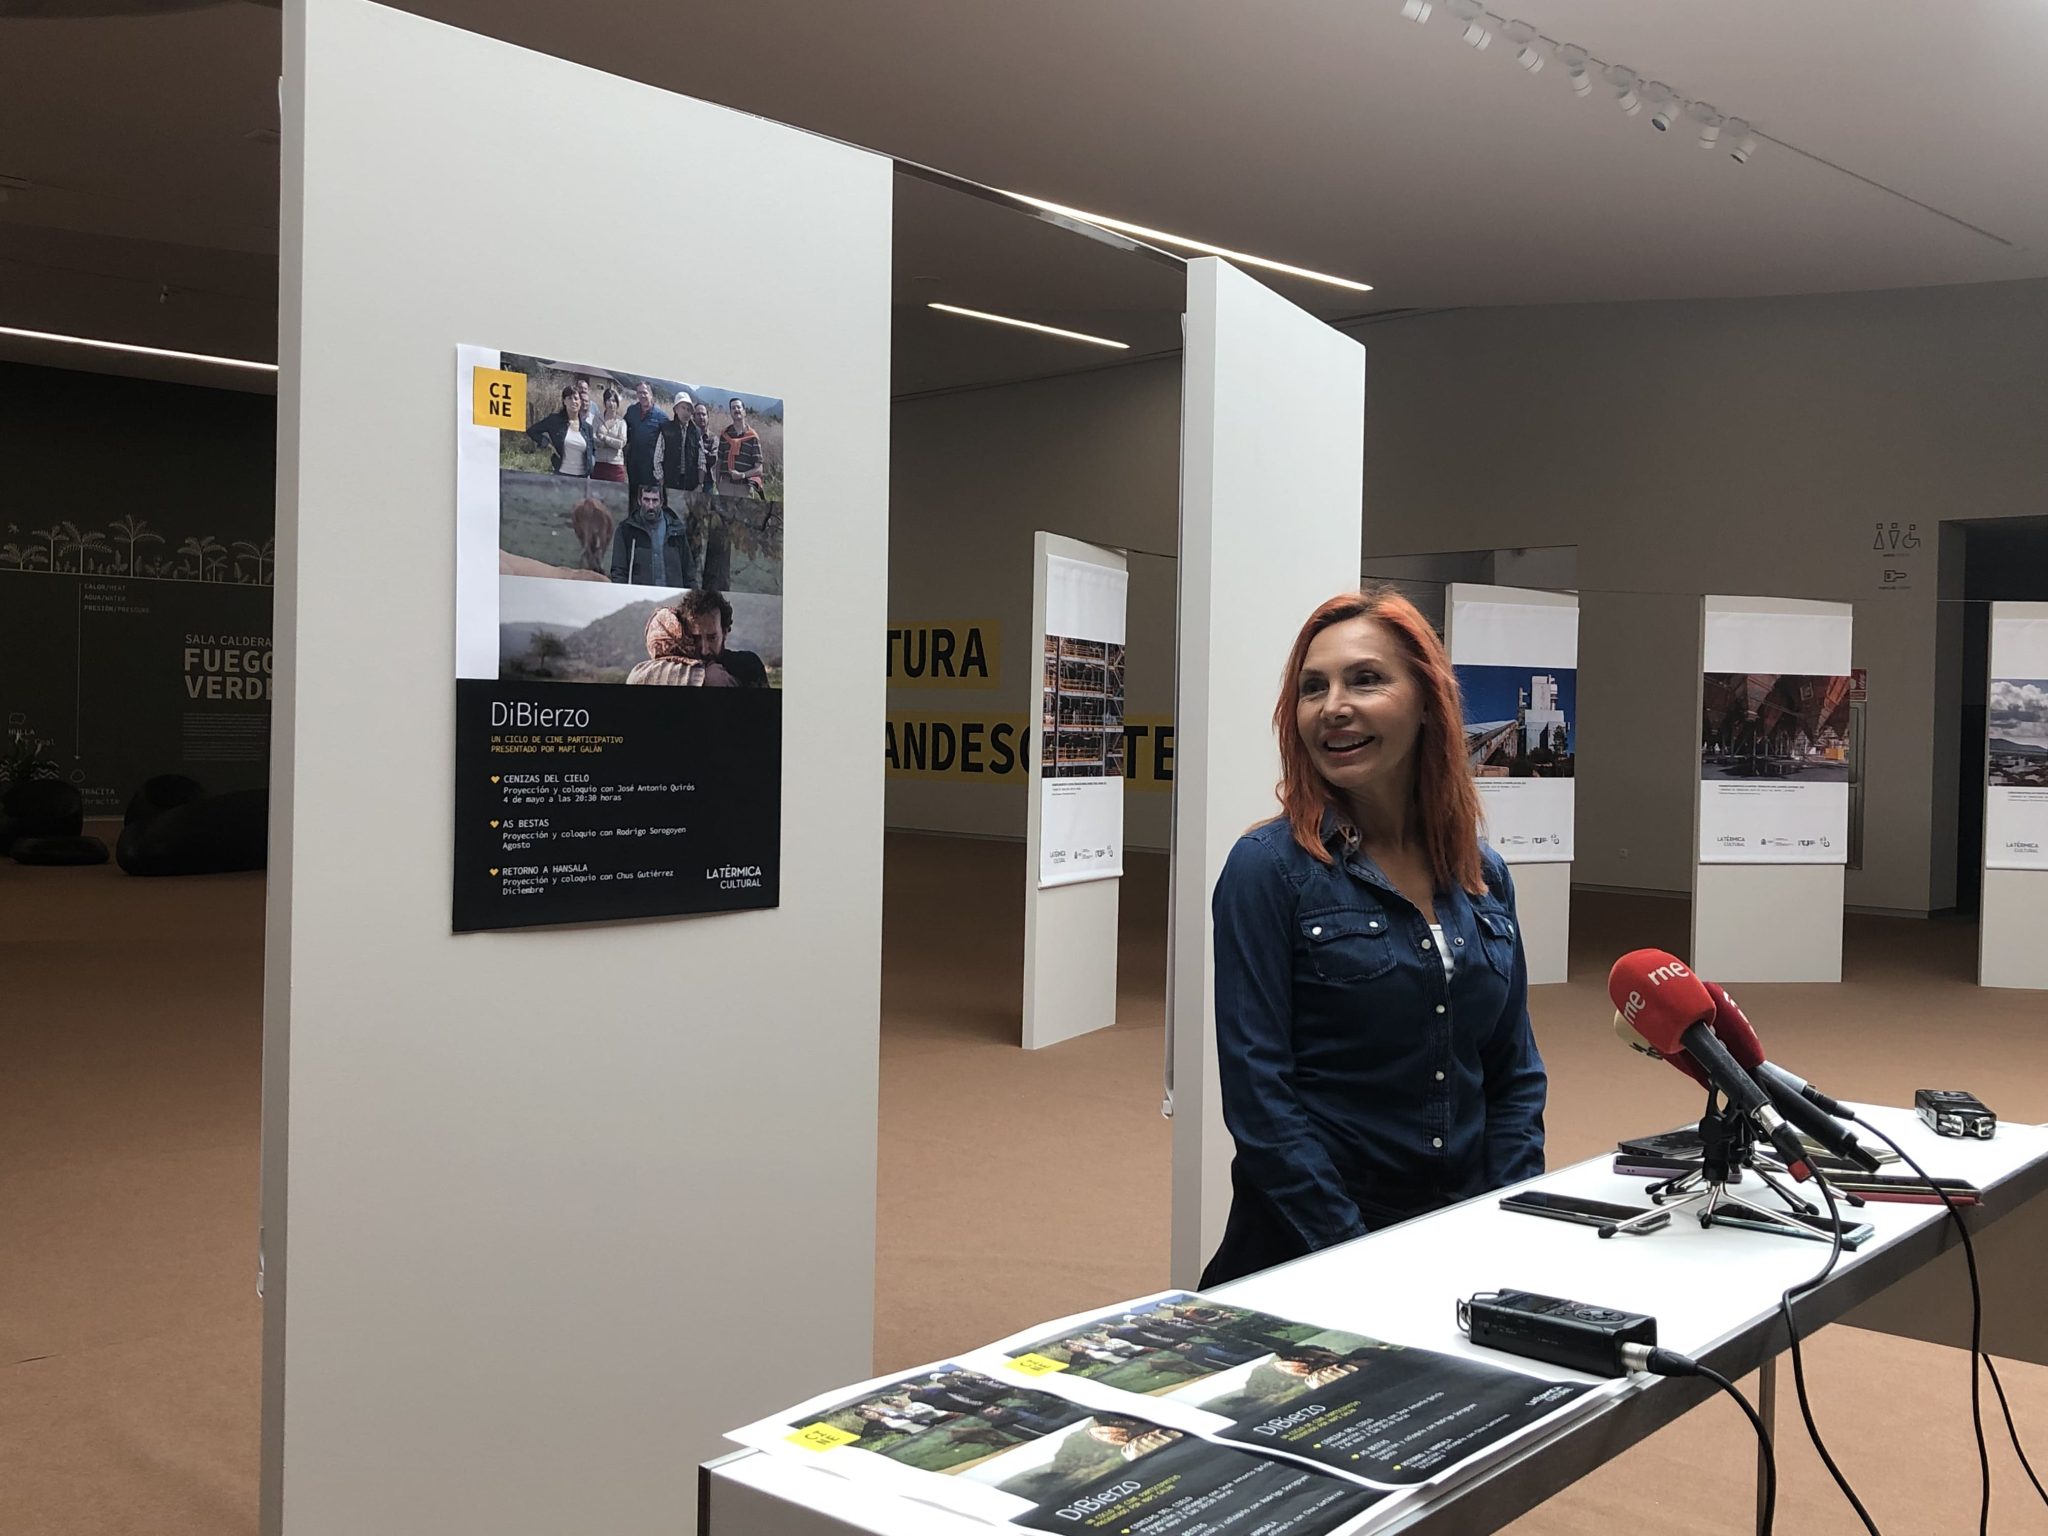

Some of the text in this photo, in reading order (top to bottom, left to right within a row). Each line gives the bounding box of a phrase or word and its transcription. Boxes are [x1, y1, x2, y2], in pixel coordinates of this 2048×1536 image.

[489, 382, 512, 399] CI
[489, 400, 512, 418] NE
[185, 634, 216, 645] SALA
[491, 701, 590, 728] DiBierzo
[491, 735, 501, 743] UN
[504, 736, 528, 744] CICLO
[504, 774, 590, 783] CENIZAS DEL CIELO
[504, 786, 549, 795] Proyección
[553, 787, 558, 795] y
[562, 784, 597, 794] coloquio
[618, 784, 634, 792] José
[503, 819, 550, 828] AS BESTAS
[503, 831, 548, 840] Proyección
[561, 830, 596, 838] coloquio
[616, 827, 646, 836] Rodrigo
[650, 827, 686, 836] Sorogoyen
[503, 842, 530, 850] Agosto
[502, 866, 538, 876] RETORNO
[552, 864, 588, 873] HANSALA
[503, 876, 548, 886] Proyección
[561, 874, 596, 884] coloquio
[638, 869, 674, 878] Gutiérrez
[720, 879, 762, 889] CULTURAL
[502, 886, 544, 895] Diciembre
[1648, 962, 1689, 986] rne
[1623, 991, 1646, 1024] rne
[1253, 1405, 1326, 1436] DiBierzo
[1056, 1480, 1141, 1520] DiBierzo
